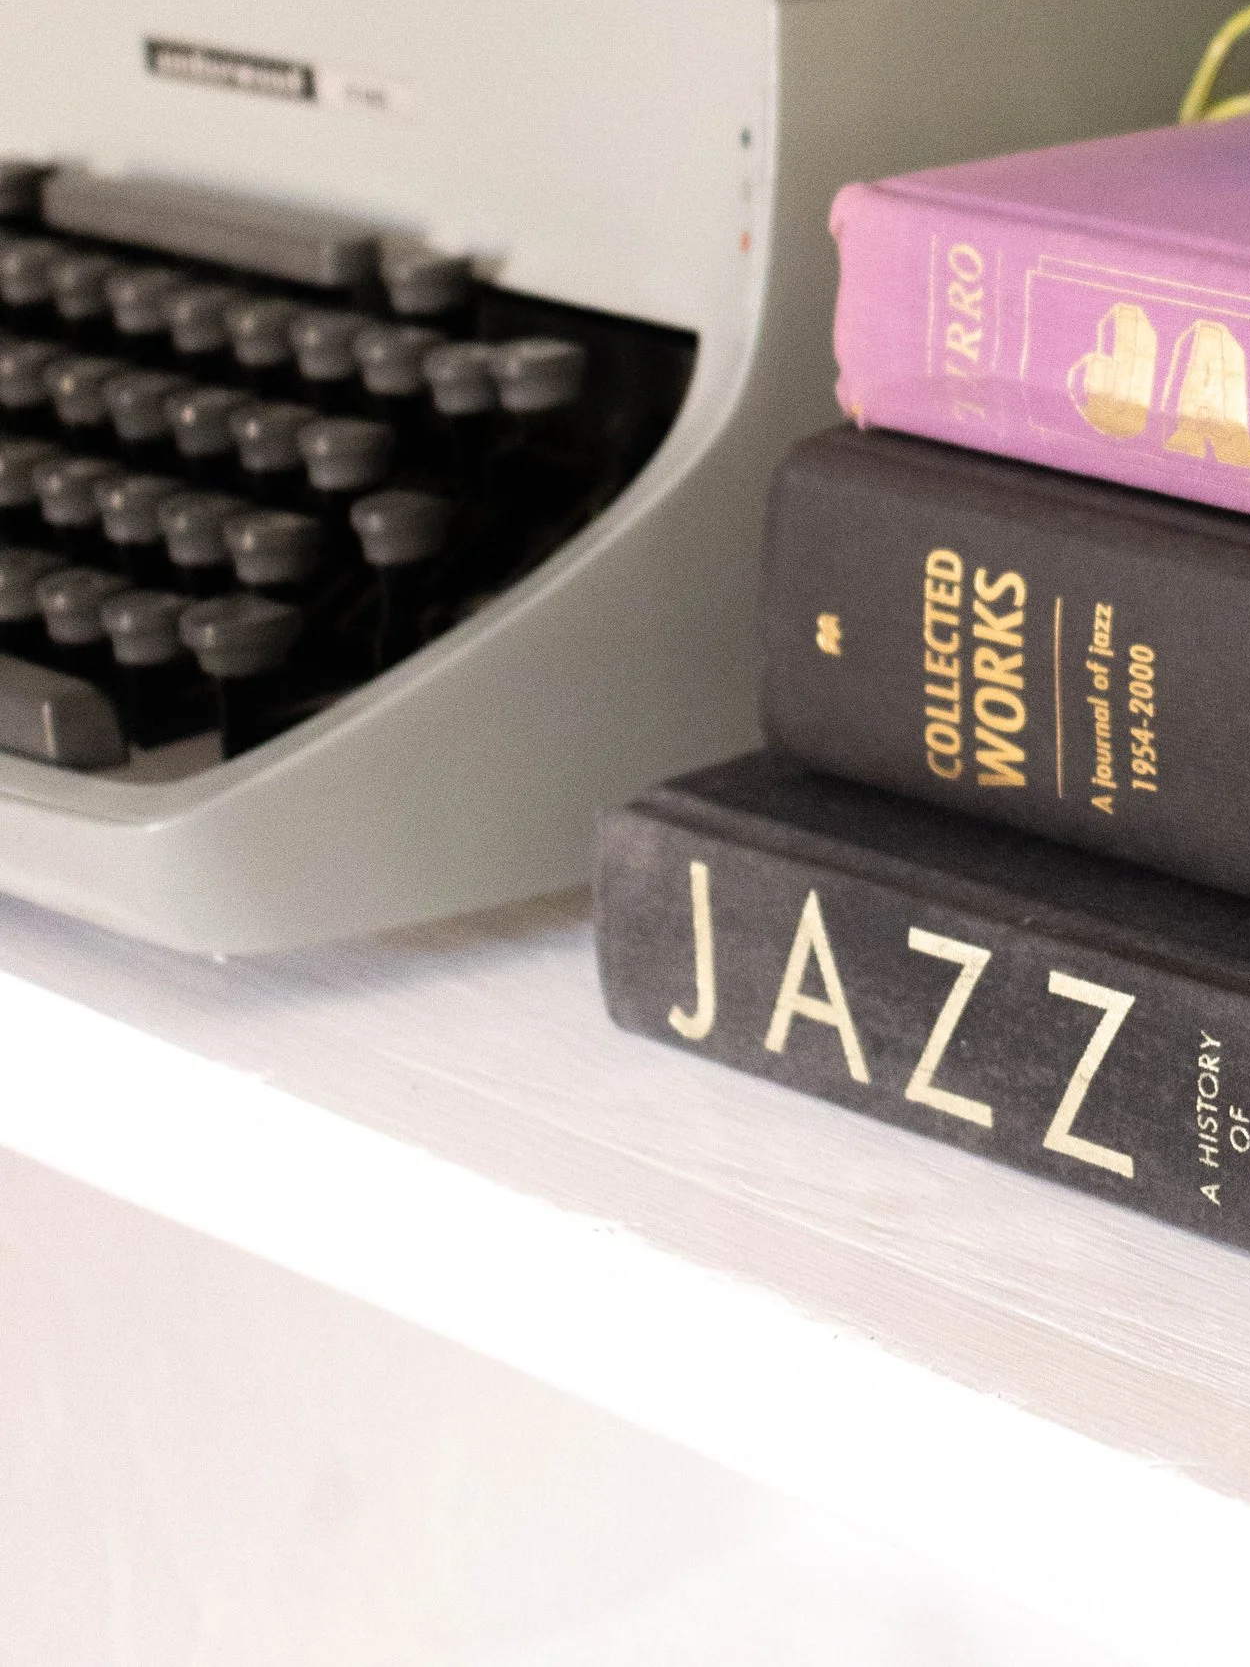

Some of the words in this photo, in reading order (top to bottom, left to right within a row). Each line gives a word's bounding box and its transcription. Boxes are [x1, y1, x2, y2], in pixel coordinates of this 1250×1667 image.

[922, 546, 965, 780] COLLECTED
[971, 565, 1028, 788] WORKS
[1084, 659, 1111, 691] of
[1087, 601, 1114, 658] jazz
[1086, 695, 1118, 790] journal
[1127, 643, 1158, 793] 1954-2000
[1090, 794, 1114, 815] A
[668, 860, 1136, 1178] JAZZ
[1195, 1029, 1222, 1169] HISTORY
[1228, 1104, 1250, 1154] OF
[1199, 1183, 1222, 1207] A
